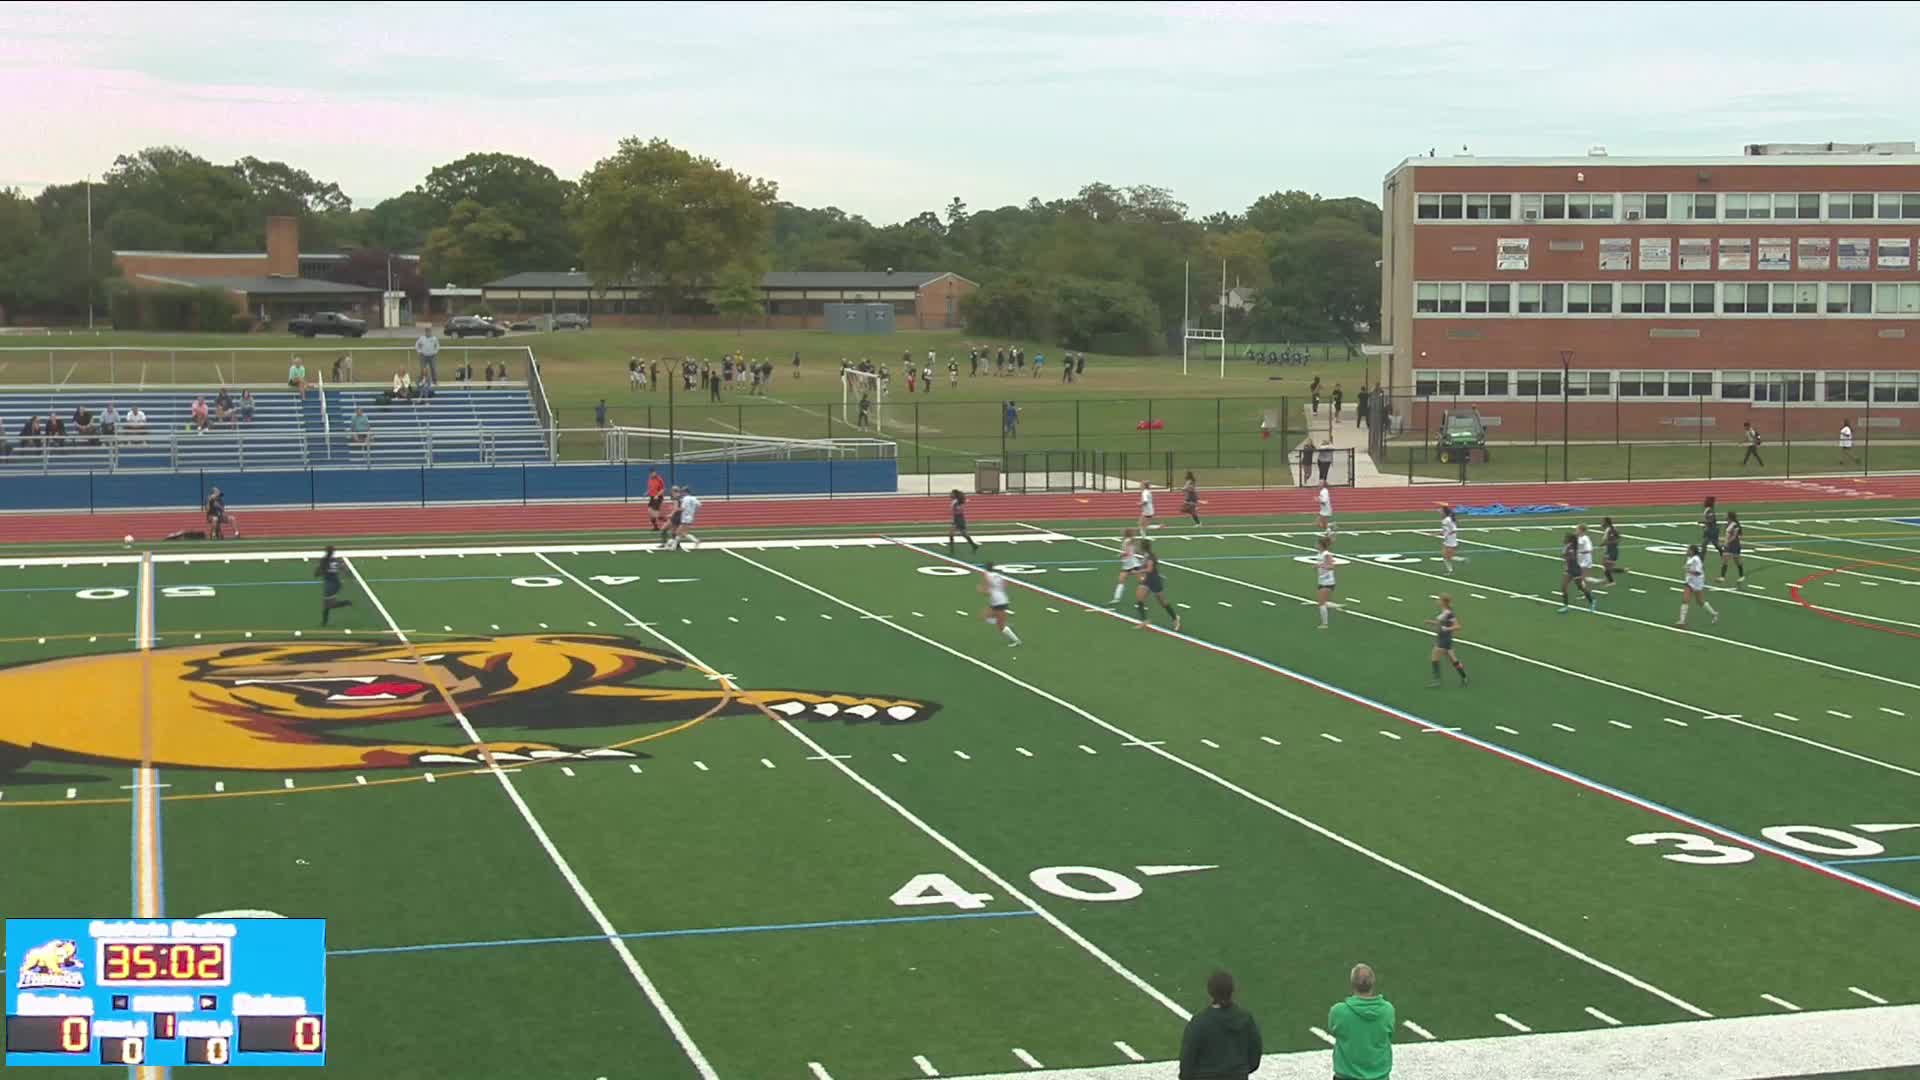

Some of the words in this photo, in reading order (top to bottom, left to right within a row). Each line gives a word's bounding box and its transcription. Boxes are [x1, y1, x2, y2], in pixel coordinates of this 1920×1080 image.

[917, 564, 1047, 576] 30
[511, 575, 641, 588] 40
[75, 586, 216, 599] 50
[1626, 825, 1885, 864] 30
[889, 866, 1143, 909] 40
